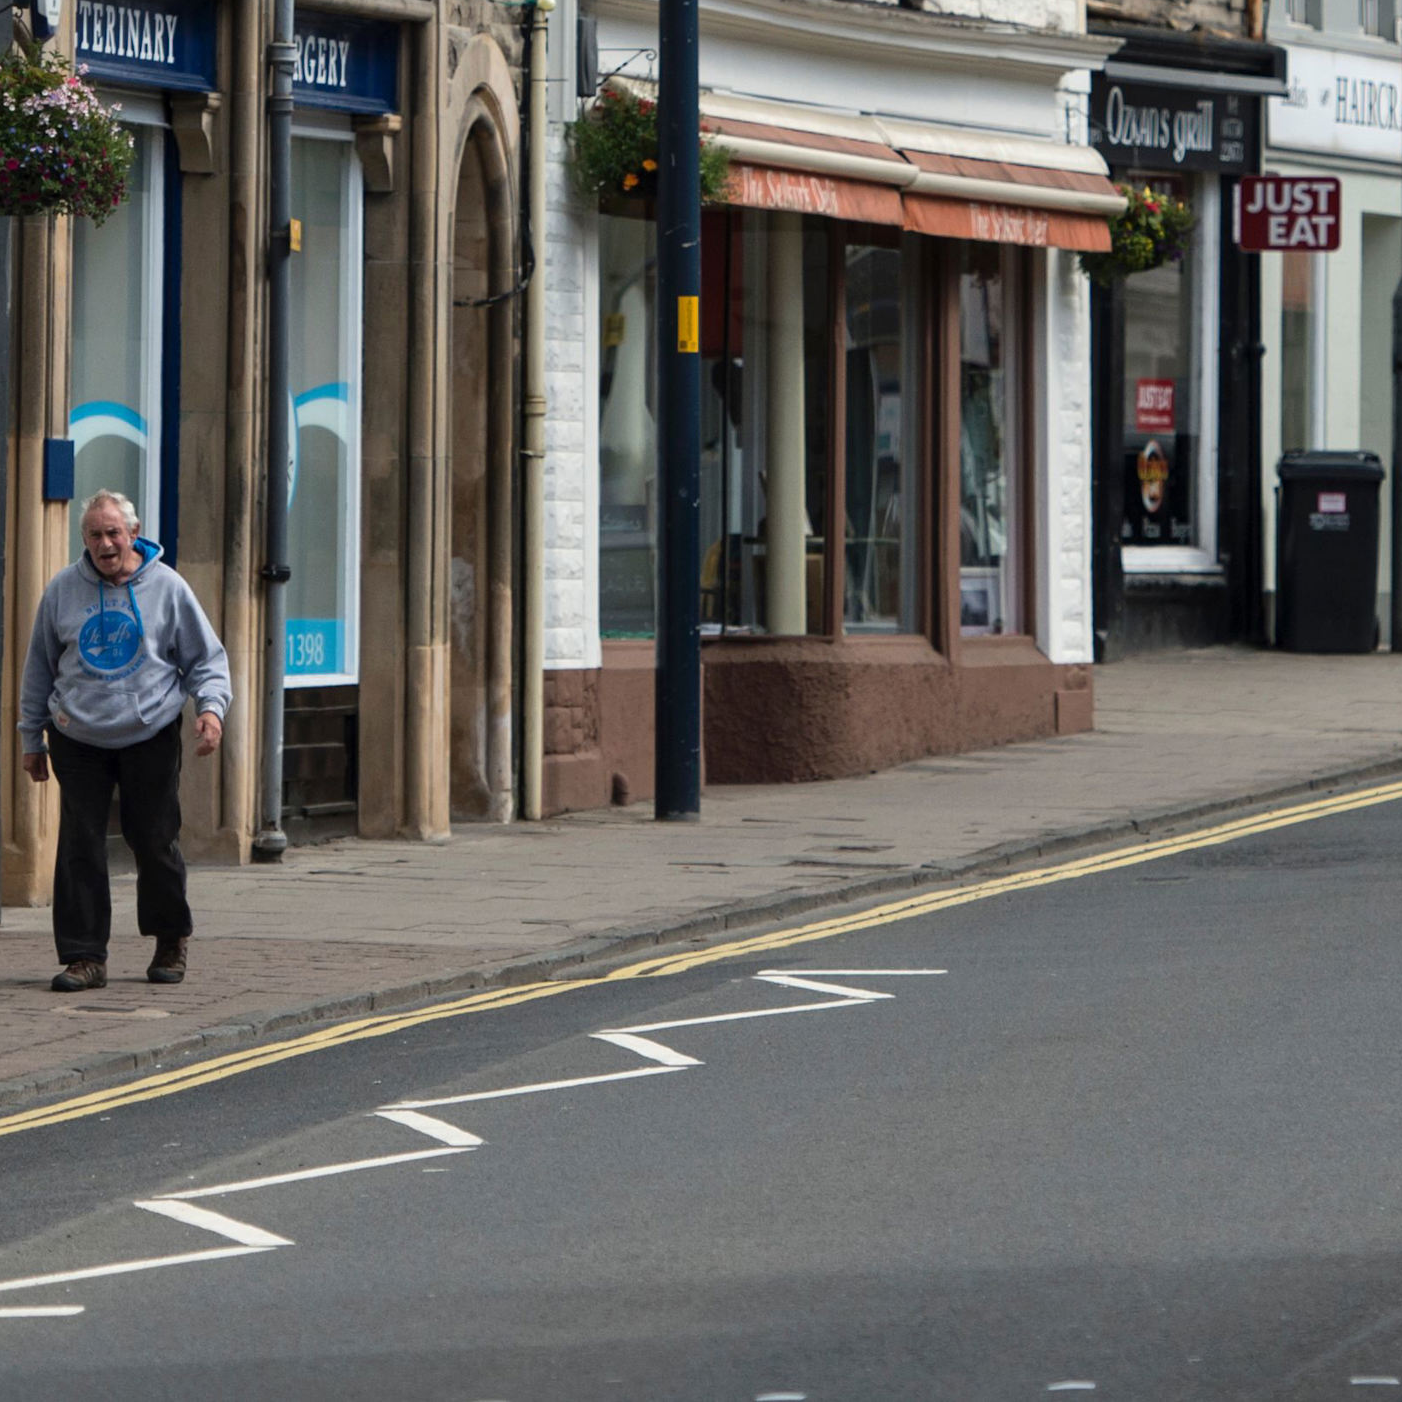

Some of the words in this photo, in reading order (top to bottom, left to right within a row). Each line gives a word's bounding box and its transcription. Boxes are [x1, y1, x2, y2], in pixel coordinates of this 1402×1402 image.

[75, 0, 178, 64] TERINARY
[292, 34, 349, 87] RGERY
[1245, 181, 1336, 214] JUST
[1268, 214, 1336, 247] EAT
[288, 633, 325, 666] 1398
